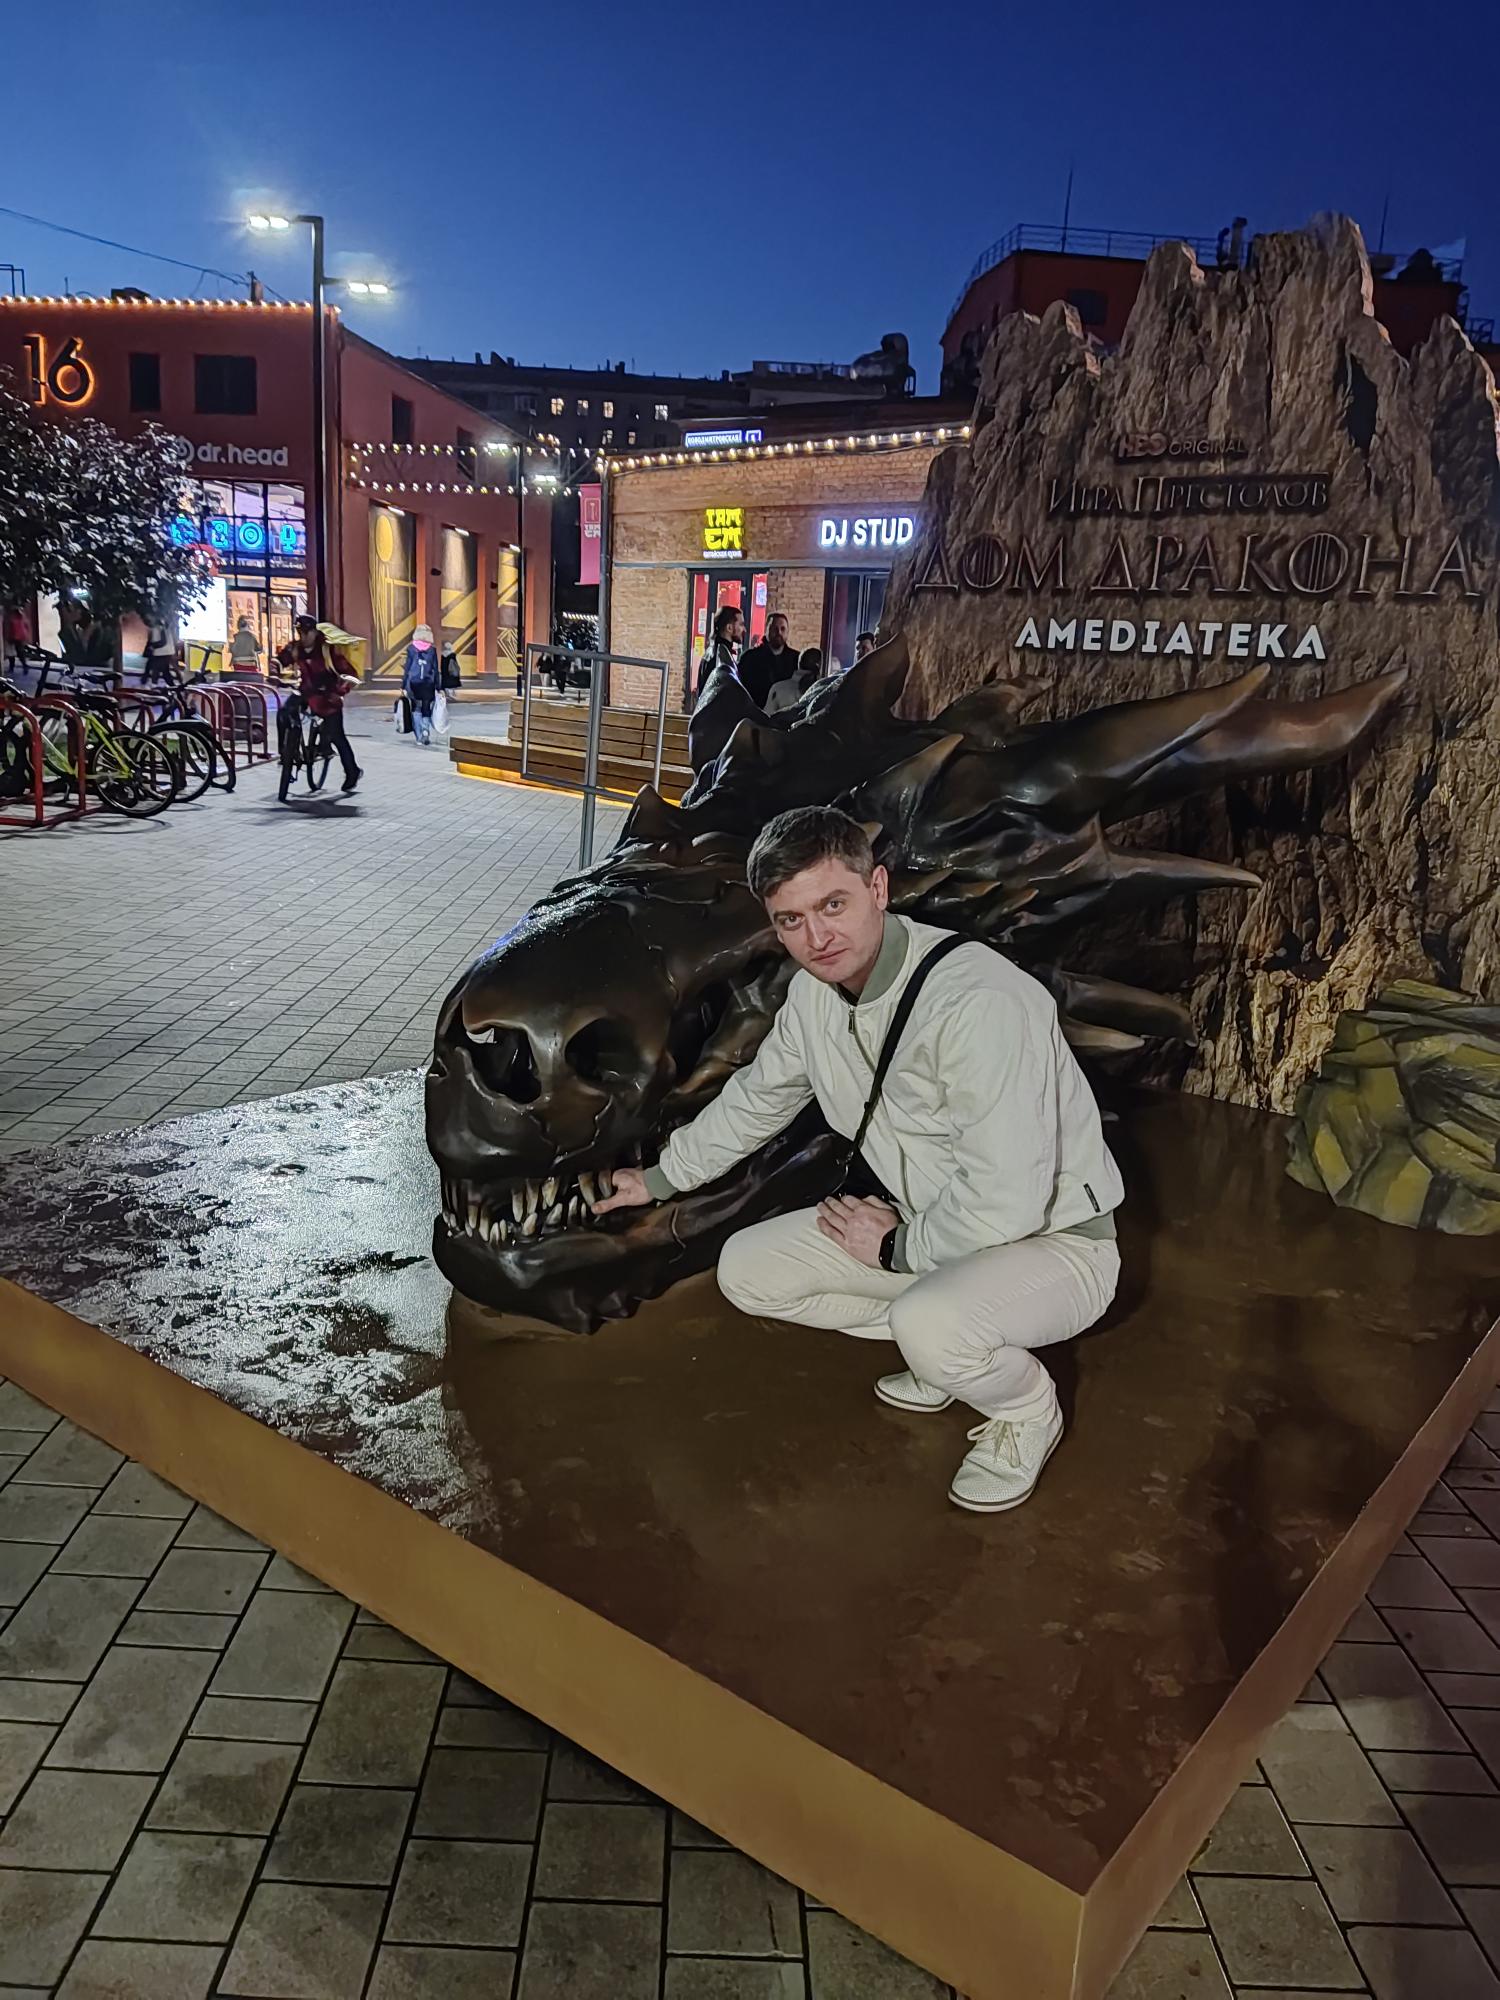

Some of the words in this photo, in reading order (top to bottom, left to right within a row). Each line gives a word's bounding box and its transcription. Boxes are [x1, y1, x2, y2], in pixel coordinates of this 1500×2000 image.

[22, 333, 96, 408] 16
[197, 443, 289, 467] dr.head
[1118, 432, 1167, 458] HBO
[1168, 439, 1246, 456] ORIGINAL
[706, 508, 743, 527] ТАМ
[704, 527, 743, 550] ЕМ
[820, 519, 848, 546] DJ
[914, 533, 1070, 592] ДОМ
[1090, 531, 1482, 597] ДРАКОНА
[1014, 616, 1327, 660] AMEDIATEKA
